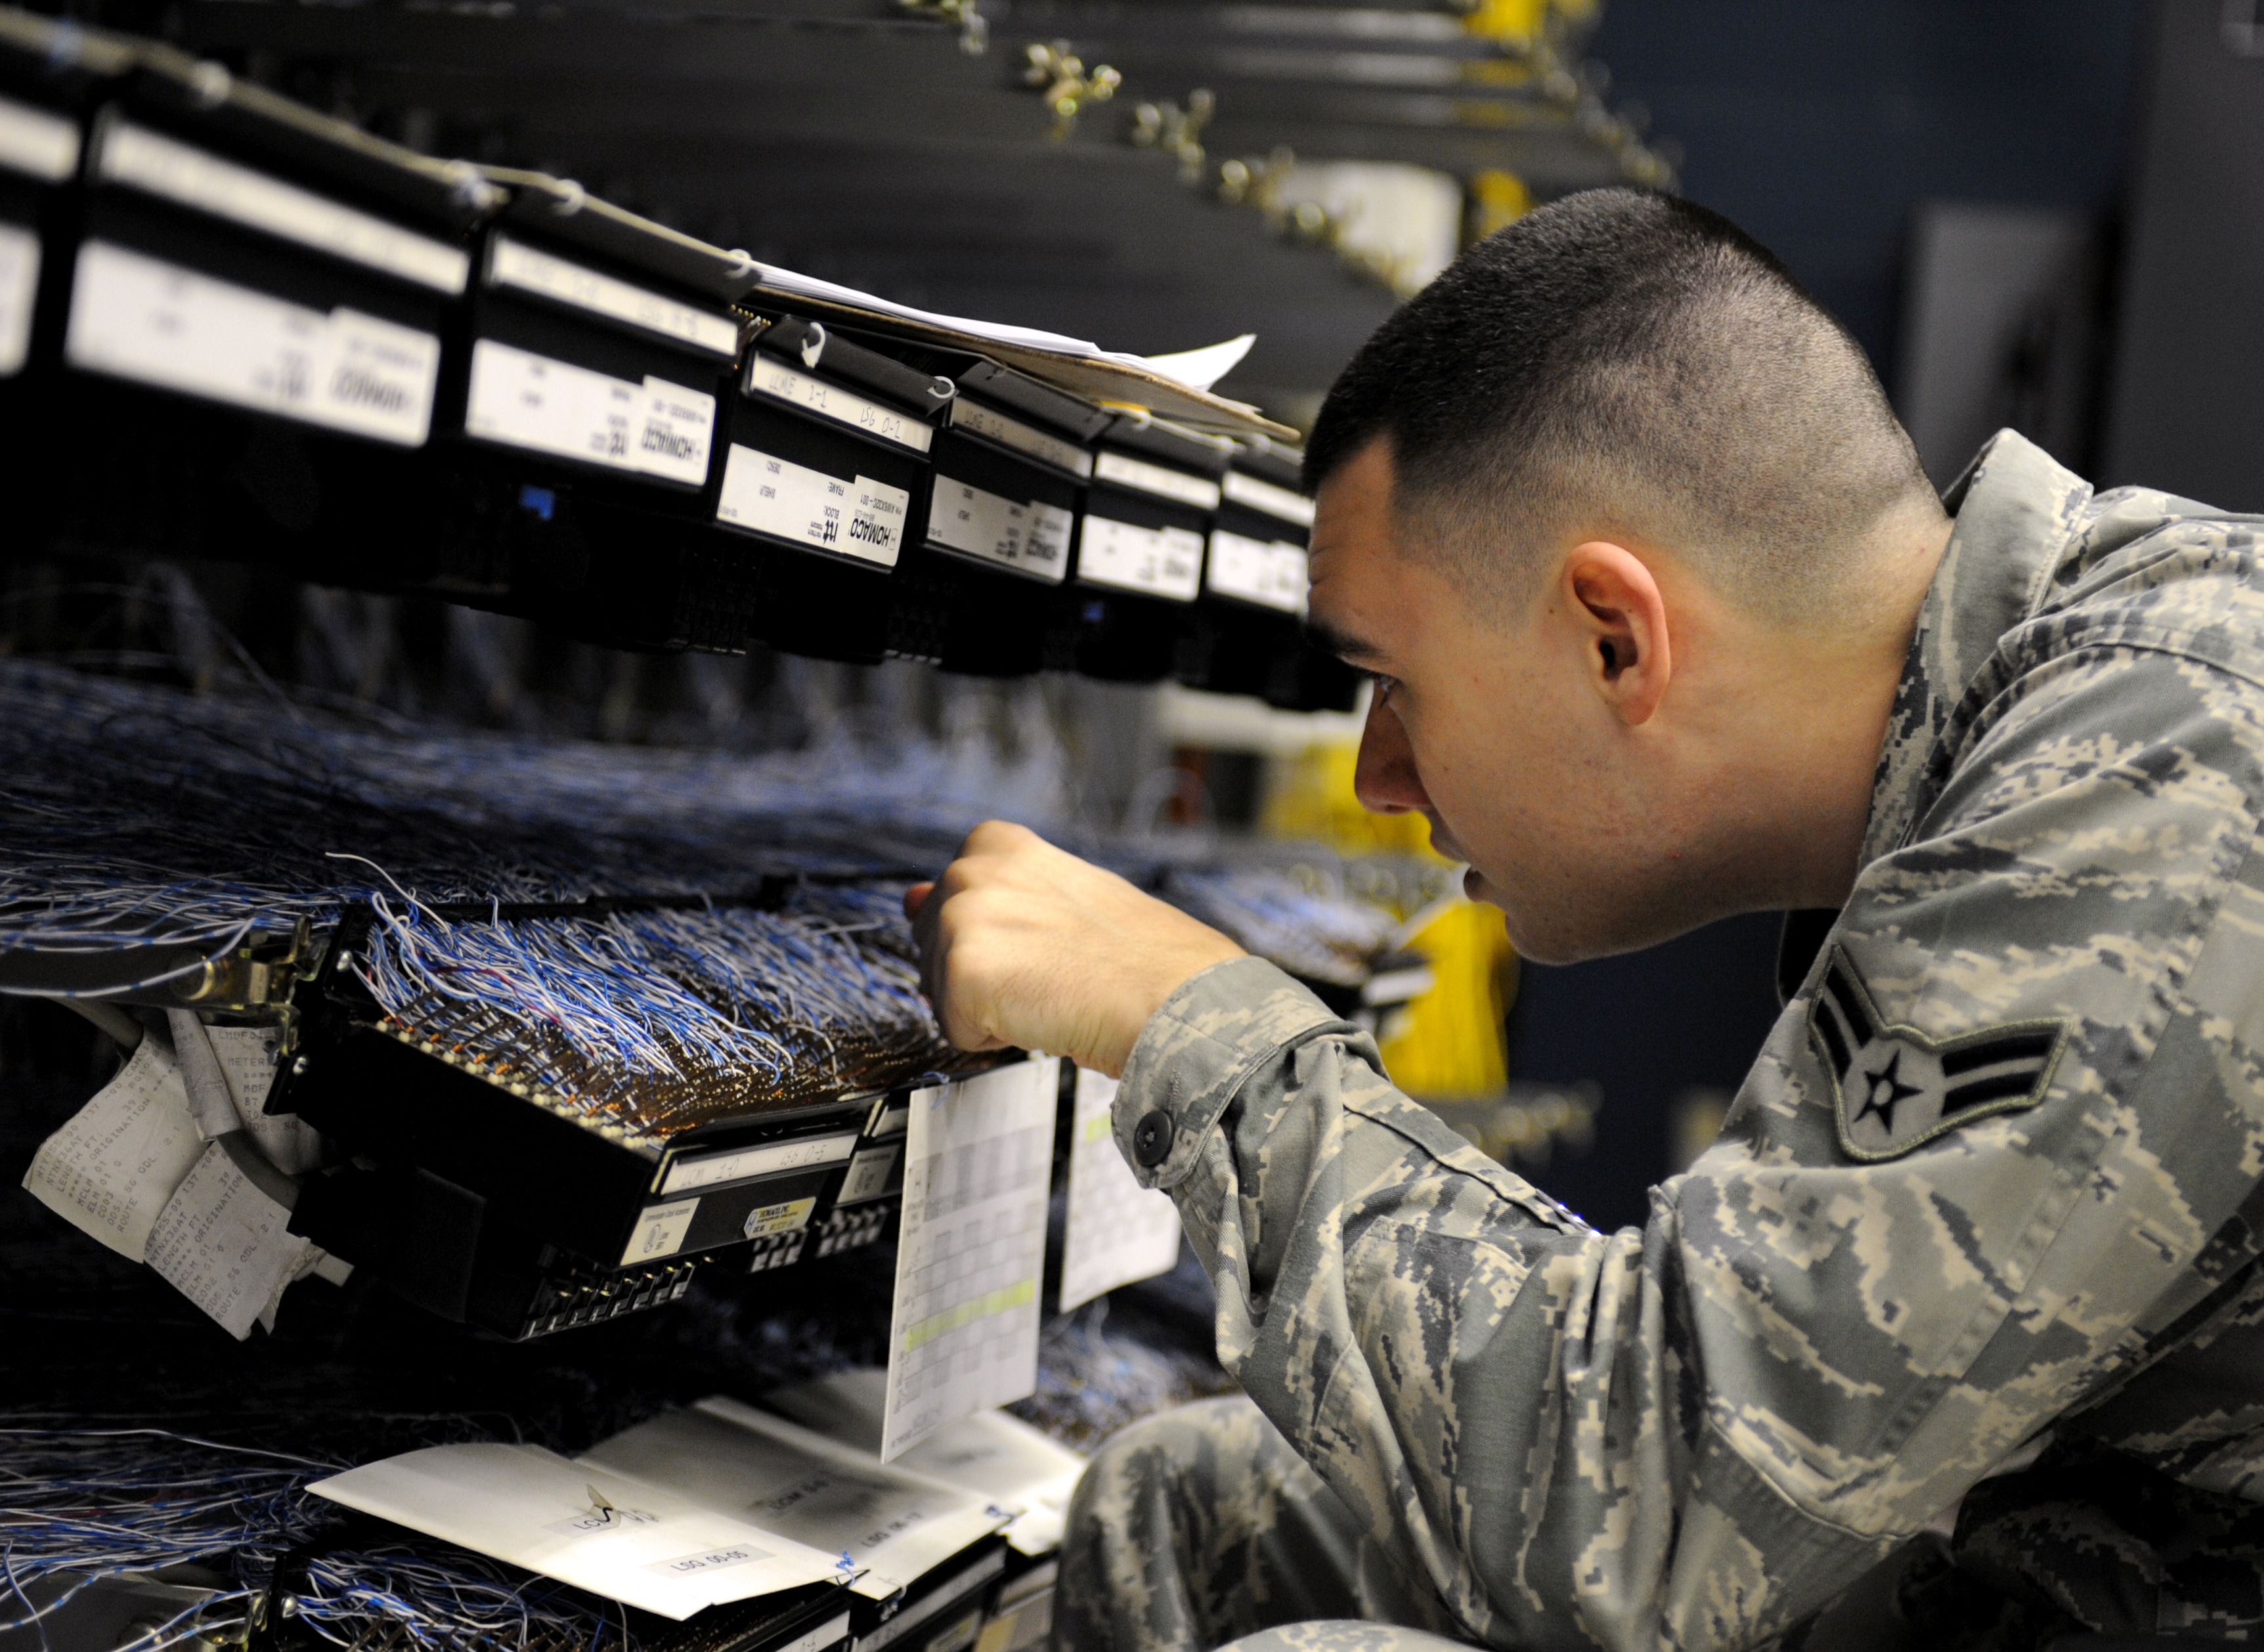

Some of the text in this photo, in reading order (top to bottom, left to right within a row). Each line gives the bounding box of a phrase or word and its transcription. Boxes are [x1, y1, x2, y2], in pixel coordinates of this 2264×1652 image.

[823, 506, 840, 519] BLOCK:
[850, 518, 890, 548] HOMACO
[243, 1084, 266, 1093] MDF
[81, 1101, 101, 1121] 137
[87, 1096, 152, 1162] ORIGINATION
[56, 1151, 84, 1192] LENGTH
[181, 1173, 200, 1194] 137
[193, 1174, 245, 1244] ORIGINATION
[157, 1231, 189, 1272] LENGTH
[184, 1273, 204, 1296] ELM
